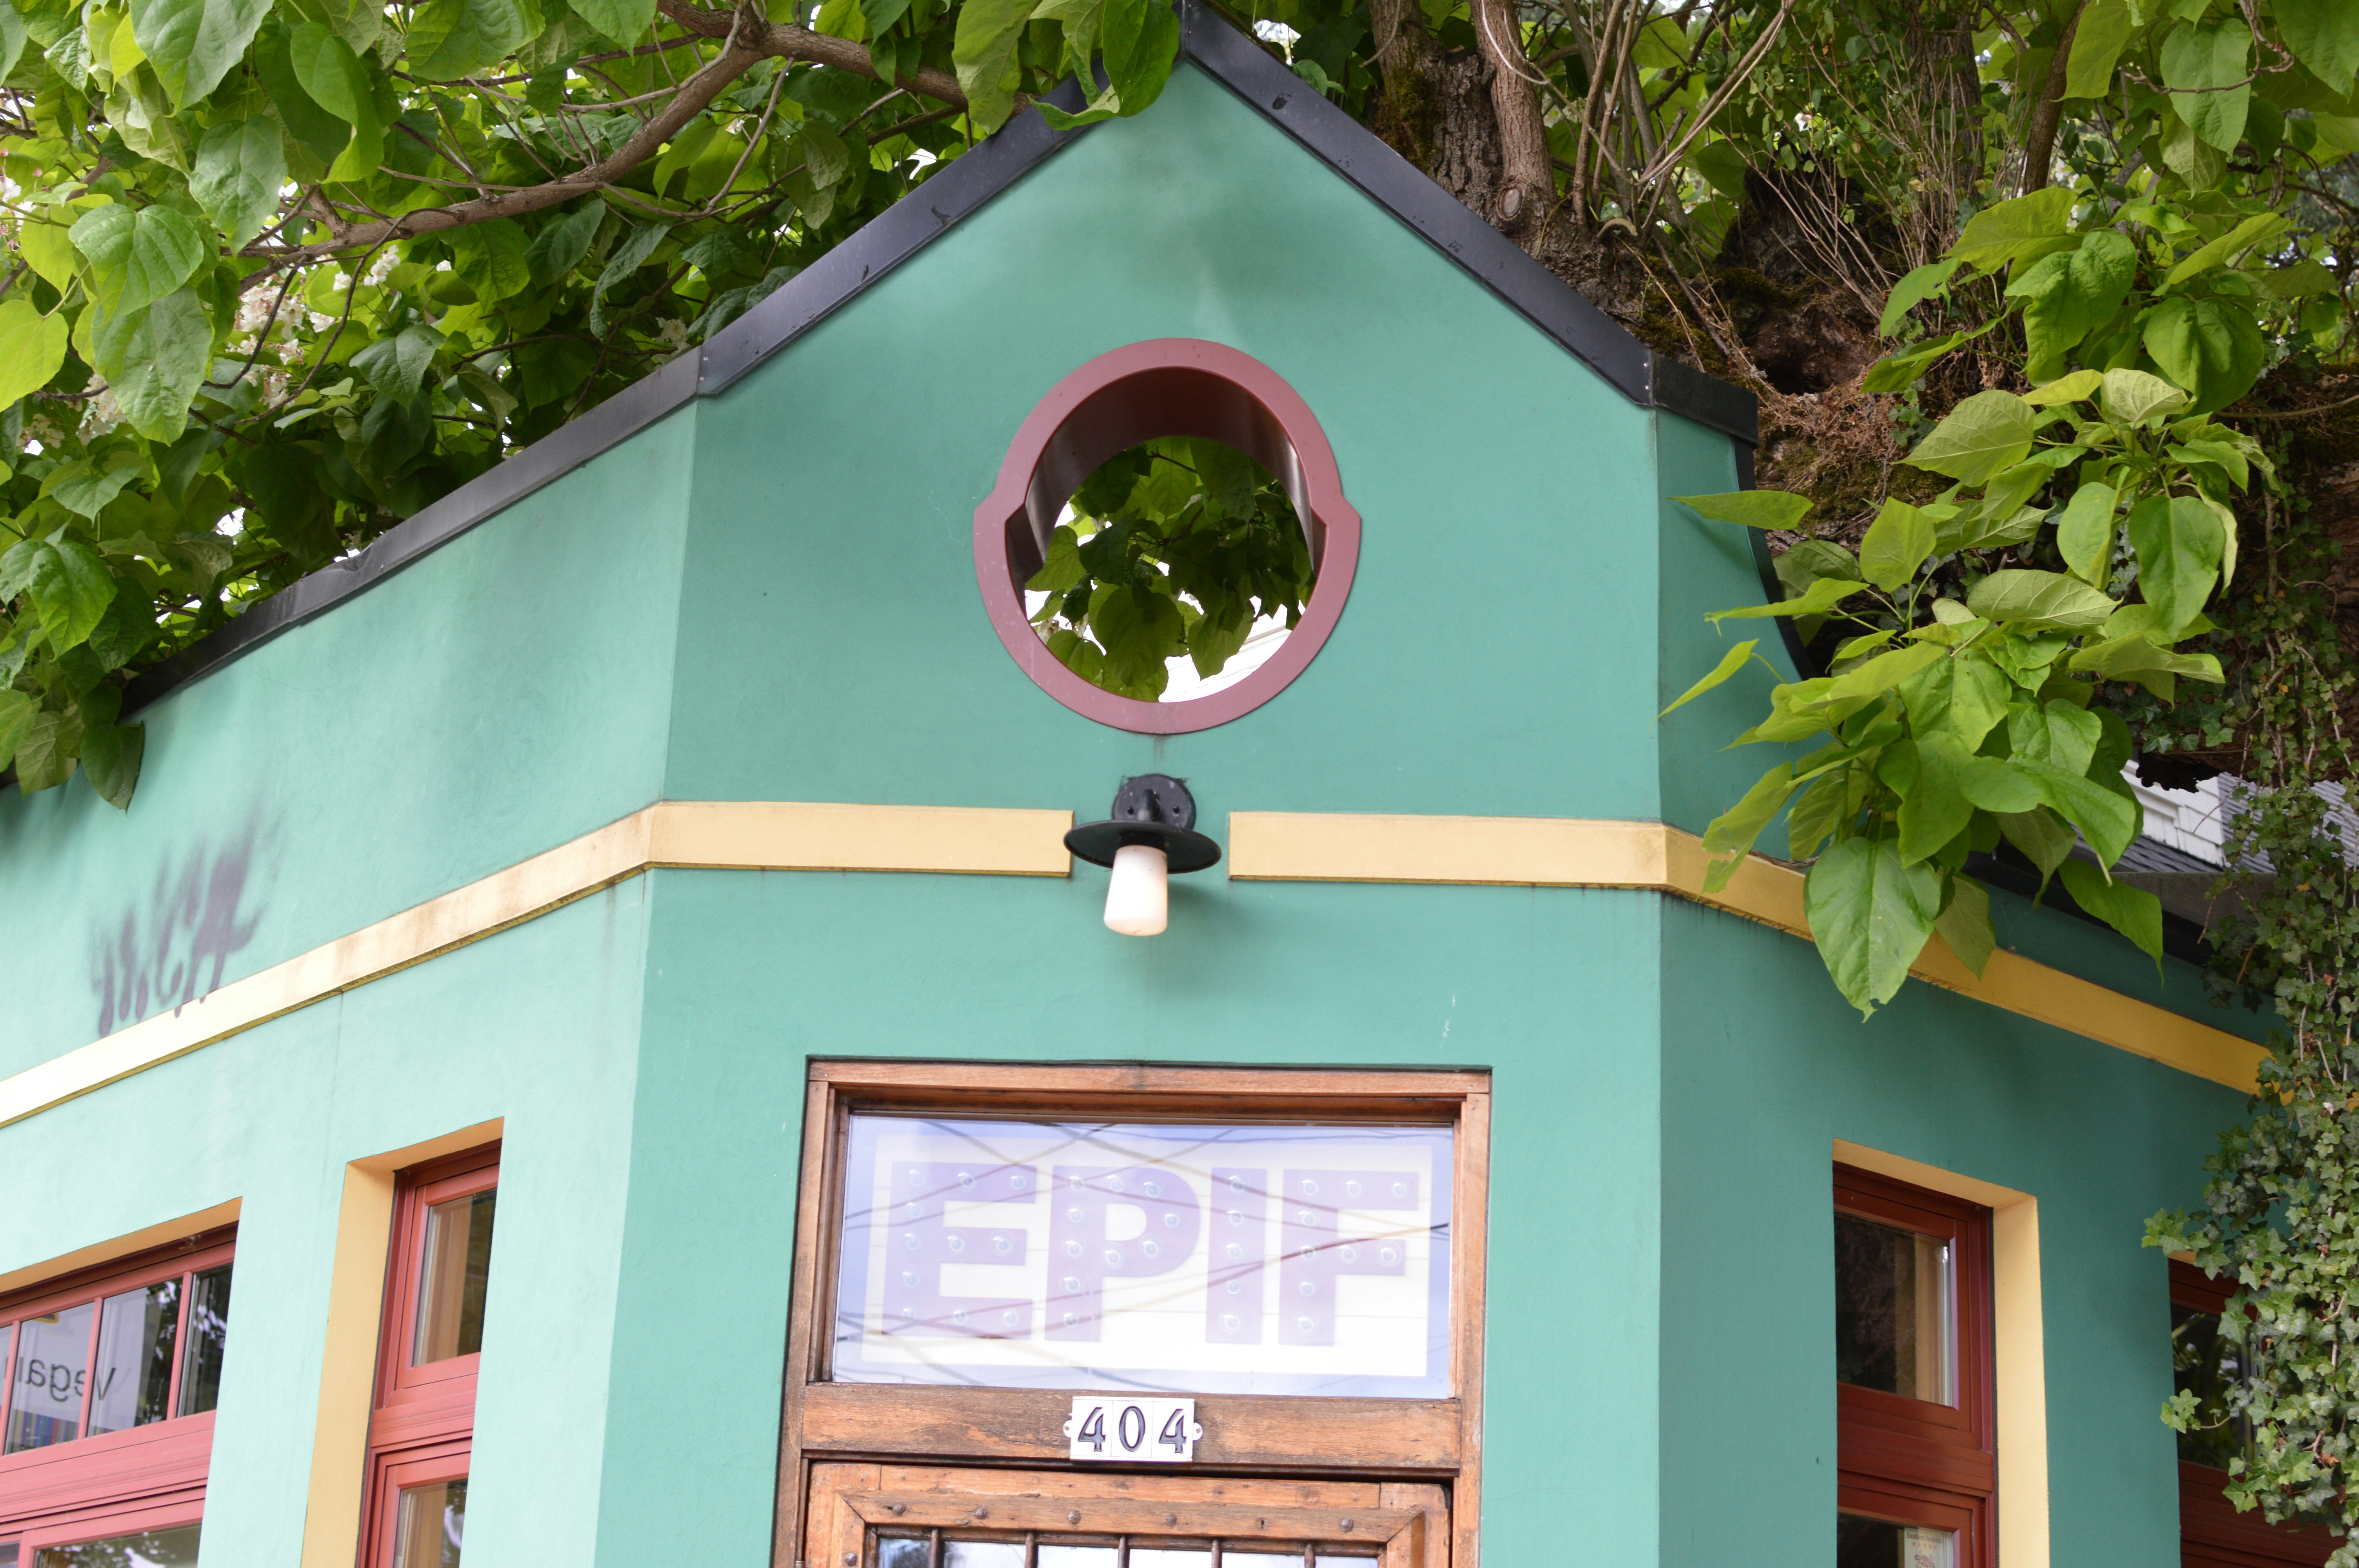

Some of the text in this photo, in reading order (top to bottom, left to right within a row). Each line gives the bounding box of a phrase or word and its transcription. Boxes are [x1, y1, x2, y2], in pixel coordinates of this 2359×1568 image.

[882, 1161, 1419, 1345] EPIF
[1077, 1405, 1187, 1454] 404
[1907, 1532, 1925, 1541] Excellent
